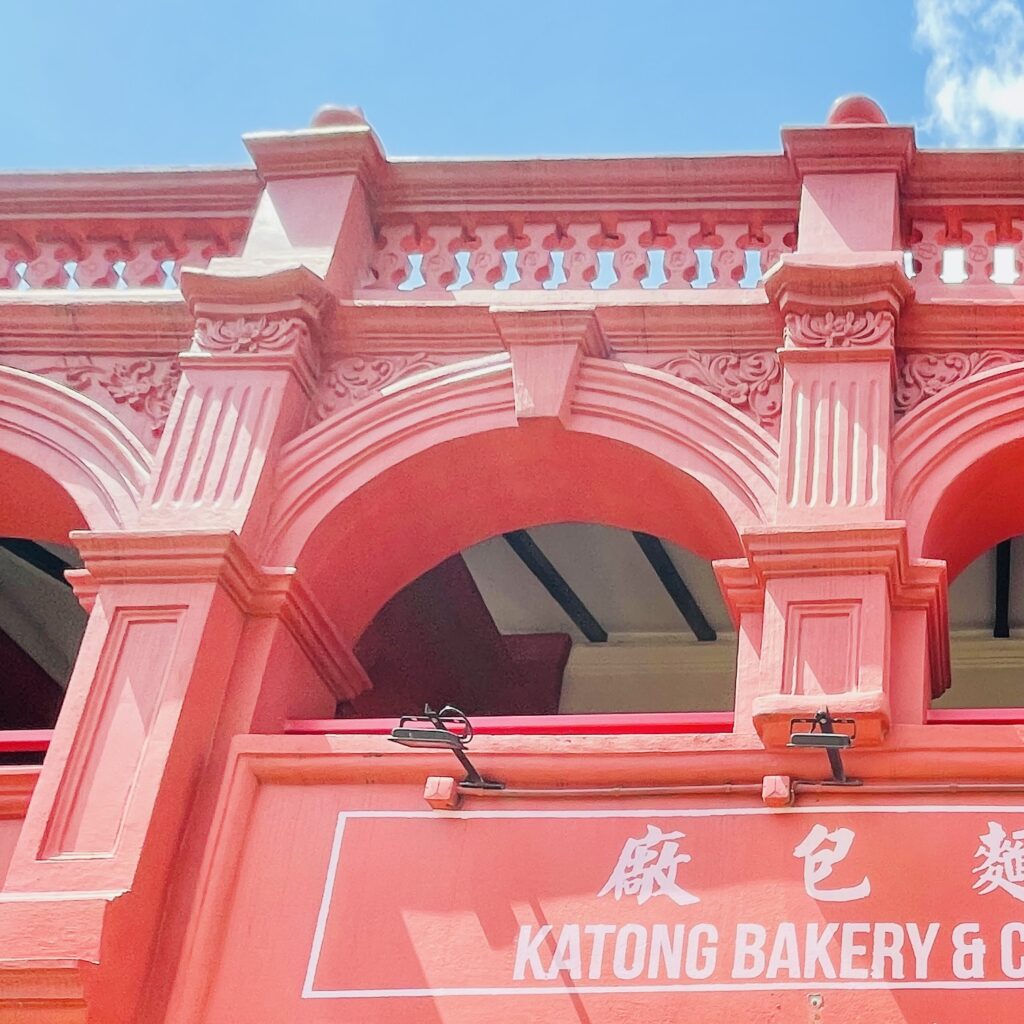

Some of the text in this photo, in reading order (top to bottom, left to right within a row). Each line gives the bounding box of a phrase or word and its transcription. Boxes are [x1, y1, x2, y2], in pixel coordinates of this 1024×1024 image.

[512, 922, 717, 982] KATONG
[731, 921, 941, 981] BAKERY
[952, 921, 984, 980] &
